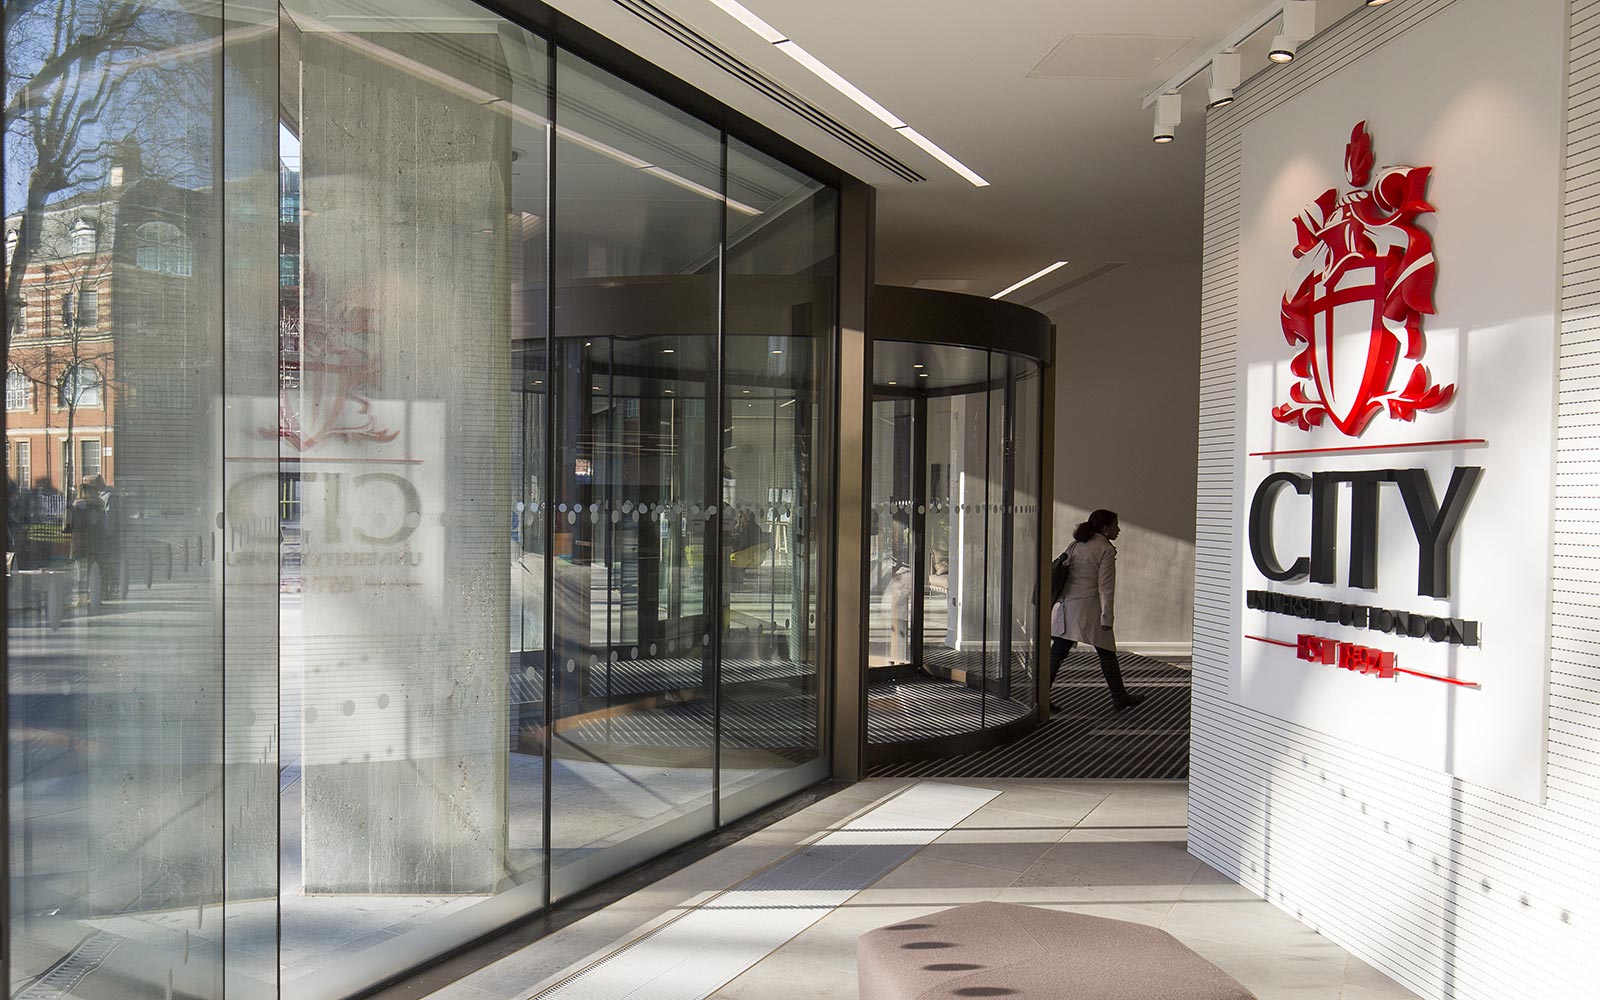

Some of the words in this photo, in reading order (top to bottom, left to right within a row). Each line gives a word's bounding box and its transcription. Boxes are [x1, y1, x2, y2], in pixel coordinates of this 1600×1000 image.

[1249, 466, 1482, 599] CITY
[1247, 590, 1340, 623] UNIVERSITY
[1338, 603, 1368, 628] OF
[1368, 607, 1478, 646] LONDON
[1297, 634, 1339, 665] EST
[1338, 642, 1395, 678] 1894
